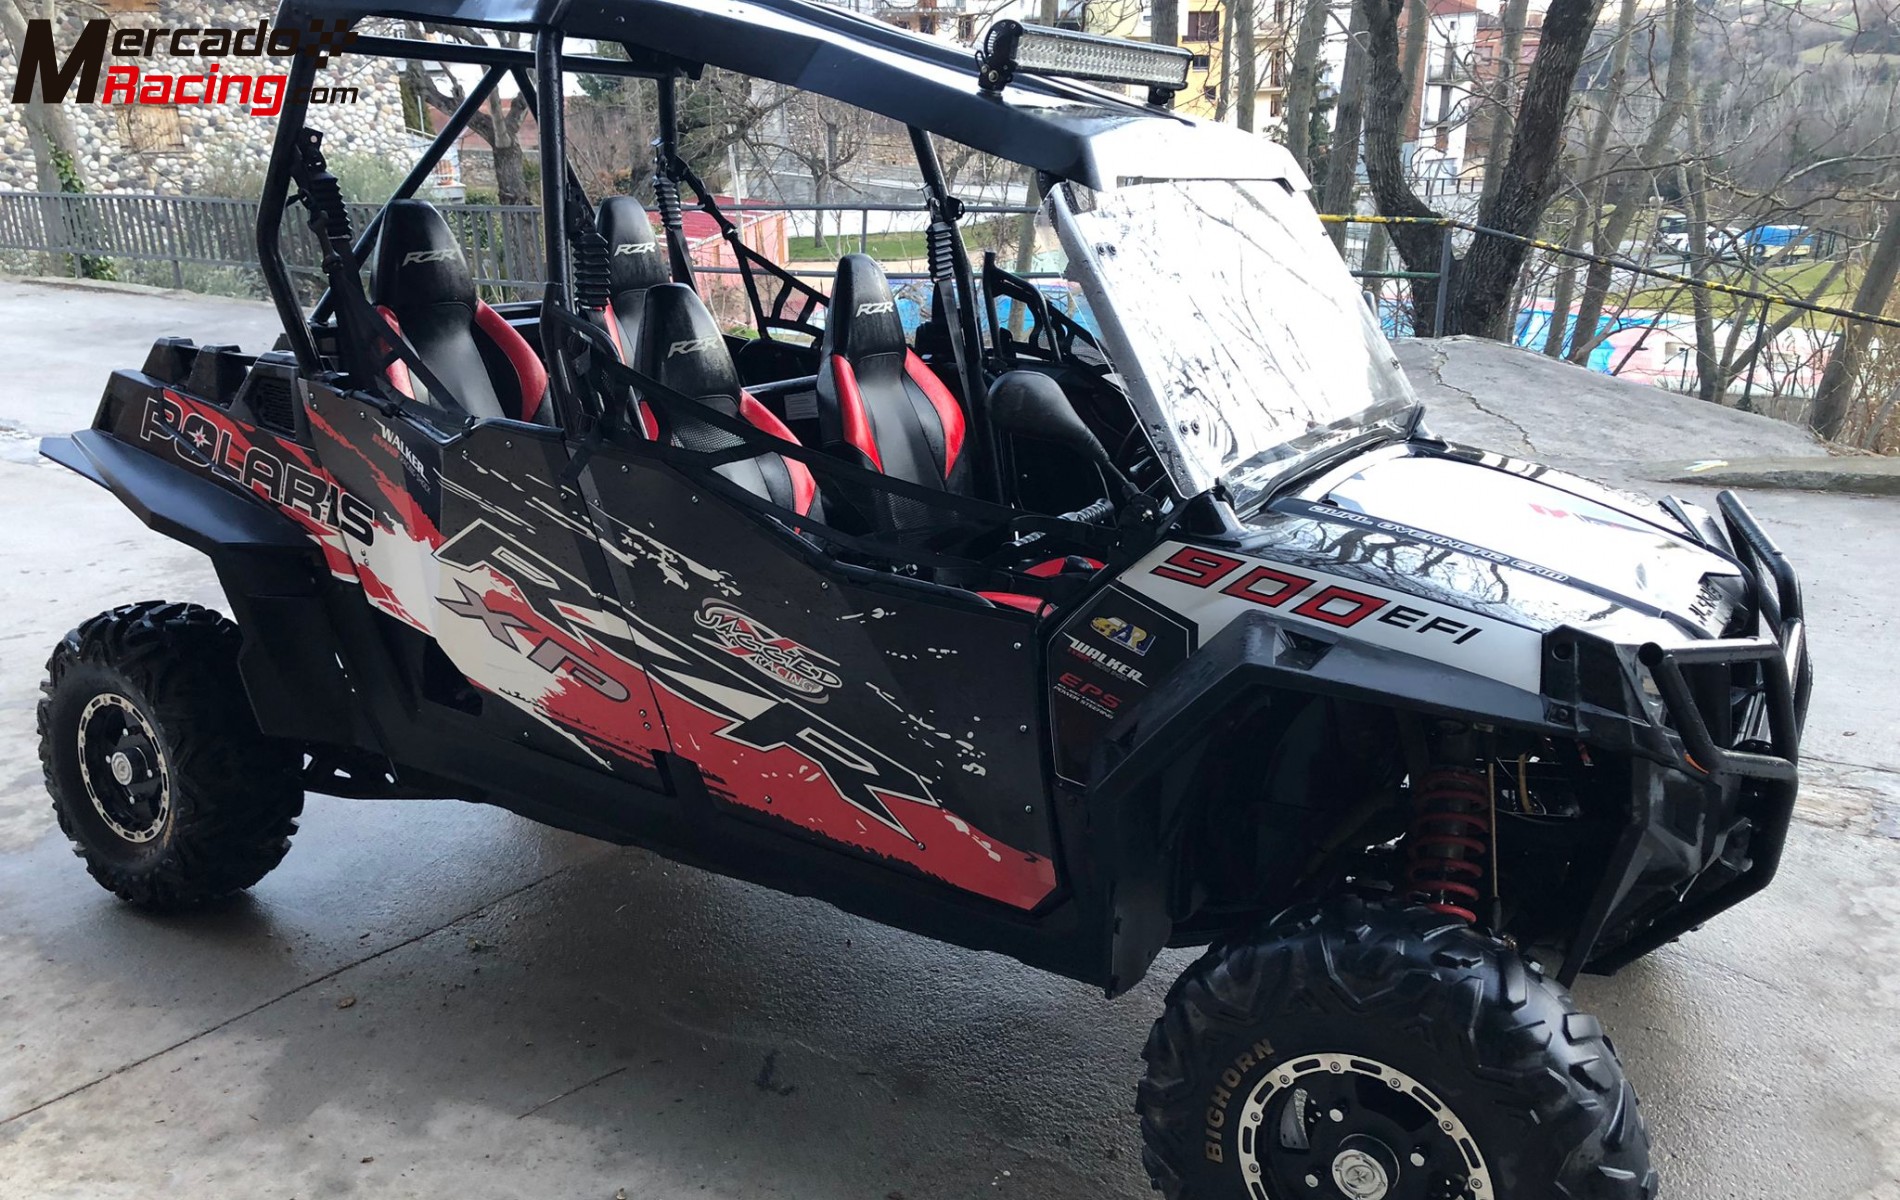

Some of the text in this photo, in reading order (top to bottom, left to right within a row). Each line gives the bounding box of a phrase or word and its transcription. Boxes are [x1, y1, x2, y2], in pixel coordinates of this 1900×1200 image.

[402, 249, 457, 266] RZR
[614, 242, 656, 256] RZR
[856, 302, 894, 317] RZR
[668, 337, 719, 358] RZR
[372, 417, 430, 484] WALKER
[140, 397, 375, 547] POLARIS
[1149, 545, 1391, 629] 900
[1377, 605, 1483, 645] EFI
[694, 609, 843, 689] JAGGED
[1063, 632, 1149, 688] WALKER
[749, 654, 815, 692] RACING
[1059, 672, 1122, 708] EPS
[1205, 1038, 1275, 1163] BIGHORN
